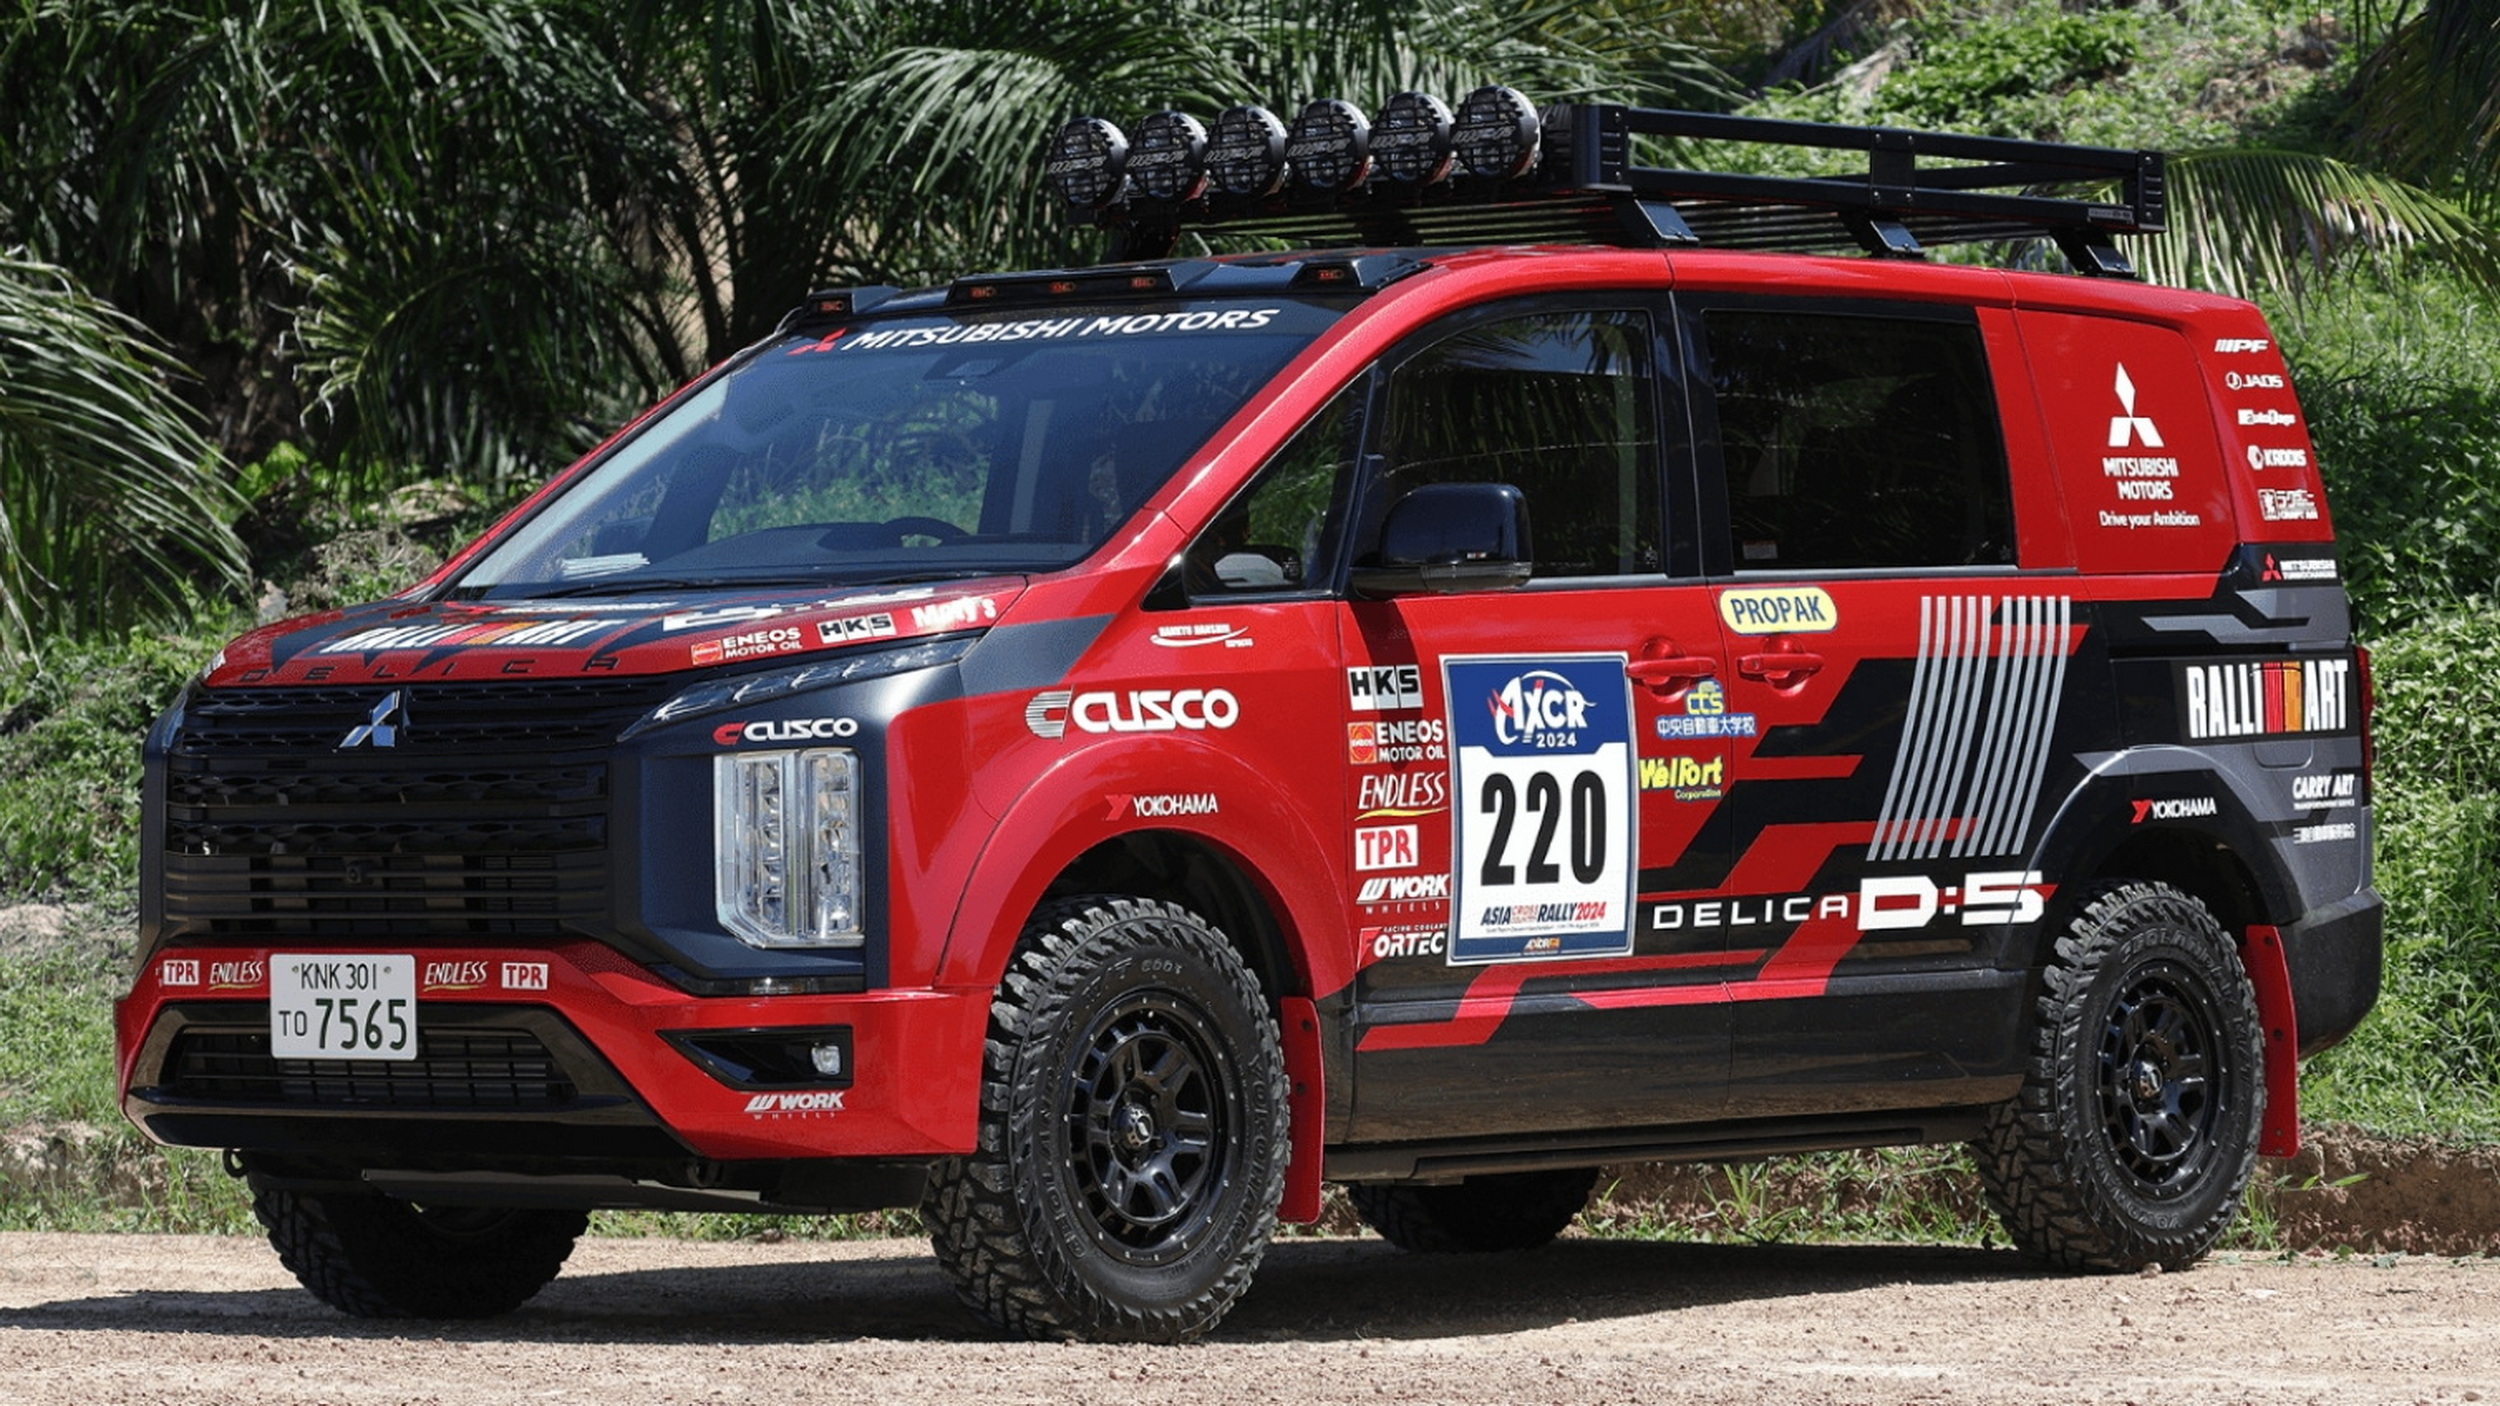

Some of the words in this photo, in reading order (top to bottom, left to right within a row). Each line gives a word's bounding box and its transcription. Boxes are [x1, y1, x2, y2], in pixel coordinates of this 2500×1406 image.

[841, 317, 1081, 350] MITSUBISHI
[1091, 309, 1281, 334] MOTORS
[2102, 457, 2179, 477] MITSUBISHI
[2117, 480, 2174, 500] MOTORS
[2099, 510, 2129, 526] Drive
[2128, 515, 2152, 530] your
[2153, 510, 2201, 526] Ambition
[1730, 596, 1826, 624] PROPAK
[722, 627, 802, 648] ENEOS
[820, 616, 893, 640] HKS
[725, 643, 776, 659] MOTOR
[779, 640, 803, 650] OIL
[240, 656, 620, 683] DELICA
[1350, 668, 1420, 697] HKS
[1072, 688, 1240, 733] CUSCO
[743, 718, 858, 741] CUSCO
[1376, 719, 1445, 745] ENEOS
[1536, 732, 1577, 748] 2024
[1379, 747, 1423, 762] MOTOR
[1426, 745, 1446, 760] OIL
[1358, 772, 1446, 809] ENDLESS
[2293, 776, 2332, 799] CARRY
[2332, 774, 2355, 797] ART
[1133, 793, 1219, 816] YOKOHAMA
[2152, 798, 2217, 819] YOKOHAMA
[1480, 770, 1607, 886] 220
[1361, 829, 1412, 866] TPR
[1389, 874, 1451, 900] WORK
[1366, 901, 1441, 914] WHEELS
[1652, 894, 1848, 930] DELICA
[1857, 870, 2044, 931] D:5
[1480, 906, 1511, 926] ASIA
[1537, 902, 1578, 922] RALLY
[1575, 901, 1607, 921] 2024
[166, 962, 195, 982] TPR
[209, 961, 264, 985] ENDLESS
[300, 963, 344, 989] KNK
[345, 962, 379, 989] 301
[425, 961, 489, 985] ENDLESS
[506, 965, 544, 987] TPR
[279, 1010, 307, 1037] TO
[315, 998, 408, 1050] 7565
[779, 1092, 845, 1110] WORK
